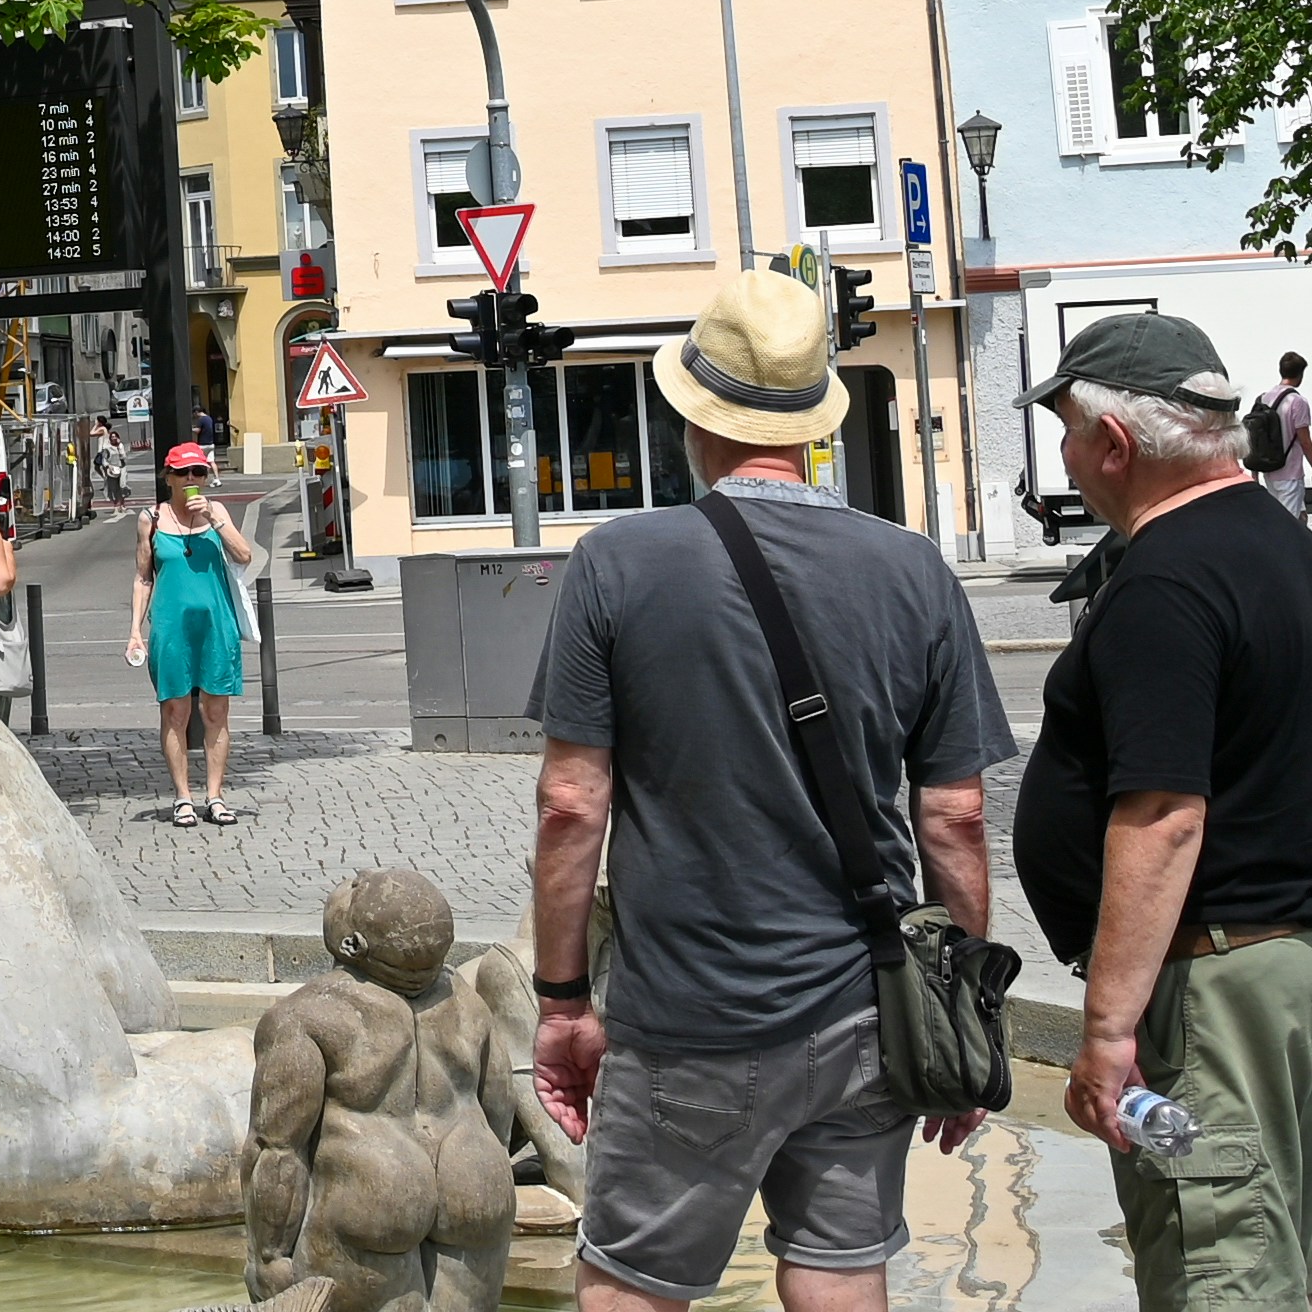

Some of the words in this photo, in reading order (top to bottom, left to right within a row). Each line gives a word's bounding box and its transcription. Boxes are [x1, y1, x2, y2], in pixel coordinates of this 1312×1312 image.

[38, 103, 46, 115] 7
[49, 101, 69, 114] min
[85, 98, 93, 111] 4
[40, 118, 55, 131] 10
[58, 117, 78, 130] min
[85, 114, 94, 127] 4
[41, 135, 56, 148] 12
[58, 133, 78, 146] min
[86, 131, 95, 143] 2
[42, 151, 57, 163] 16
[59, 149, 80, 162] min
[89, 146, 95, 159] 1
[41, 167, 57, 179] 23
[60, 165, 80, 178] min
[88, 163, 96, 175] 4
[42, 183, 58, 196] 27
[61, 181, 81, 194] min
[89, 179, 98, 192] 2
[44, 197, 78, 211] 13:53
[90, 195, 98, 208] 4
[907, 173, 922, 232] P
[45, 213, 79, 227] 13:56
[91, 211, 99, 223] 4
[46, 229, 80, 244] 14:00
[91, 227, 100, 240] 2
[47, 245, 81, 260] 14:02
[92, 243, 101, 256] 5
